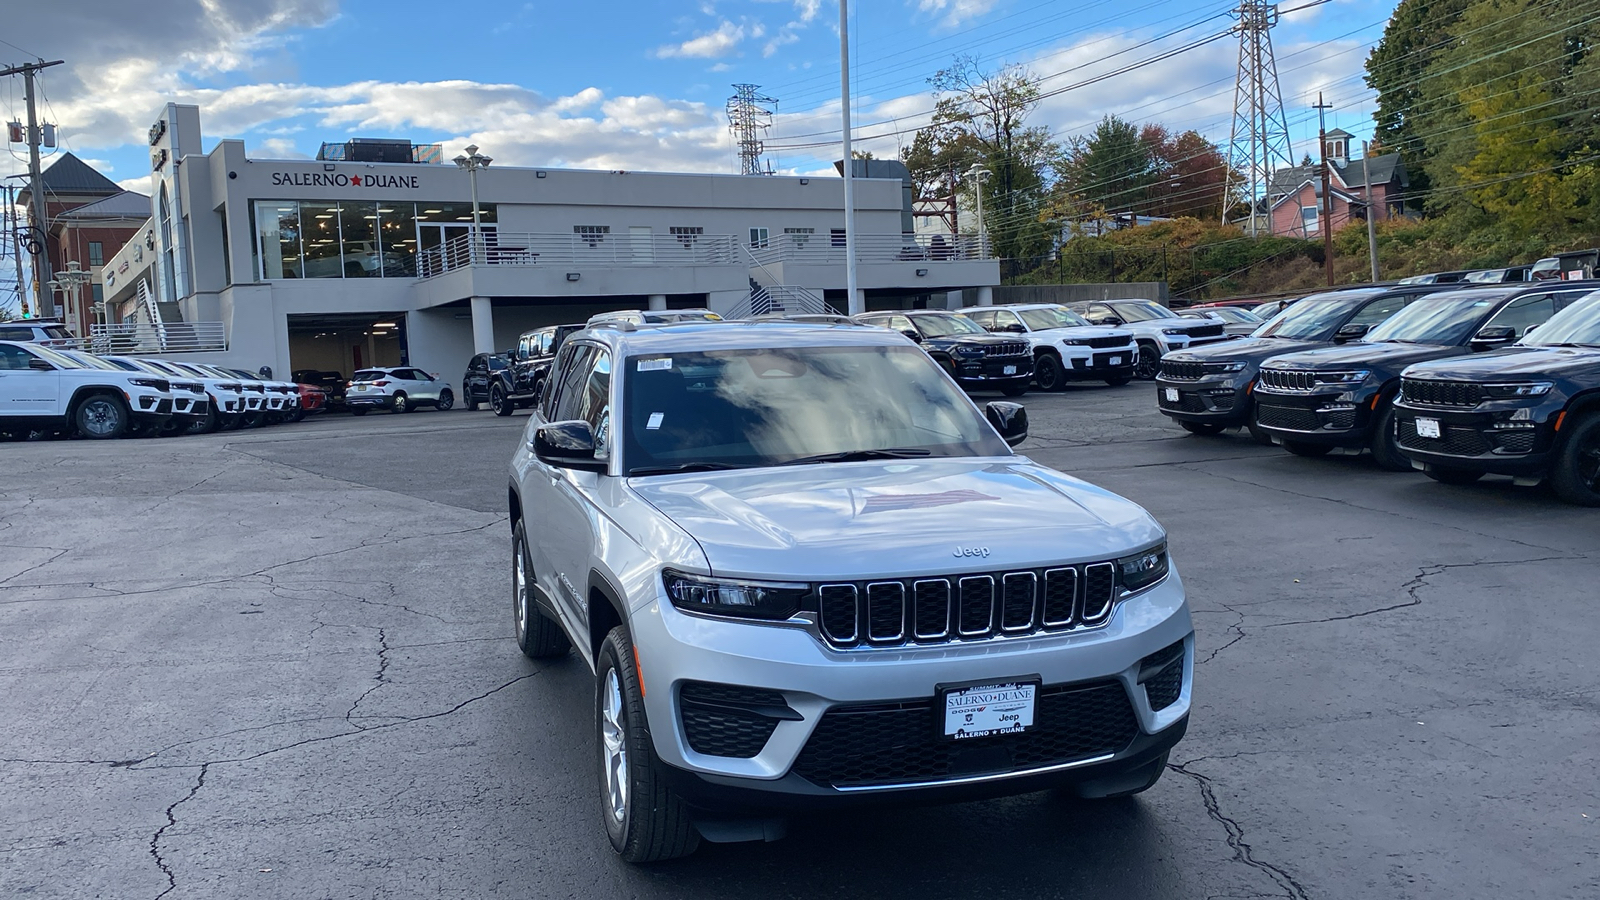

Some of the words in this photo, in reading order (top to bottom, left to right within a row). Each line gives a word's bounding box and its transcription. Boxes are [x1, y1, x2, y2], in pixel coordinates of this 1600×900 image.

[272, 172, 349, 187] SALERNO
[364, 174, 420, 189] DUANE
[952, 545, 991, 559] Jeep
[948, 694, 993, 706] SALERNO
[997, 690, 1032, 701] DUANE
[954, 730, 990, 740] SALERNO
